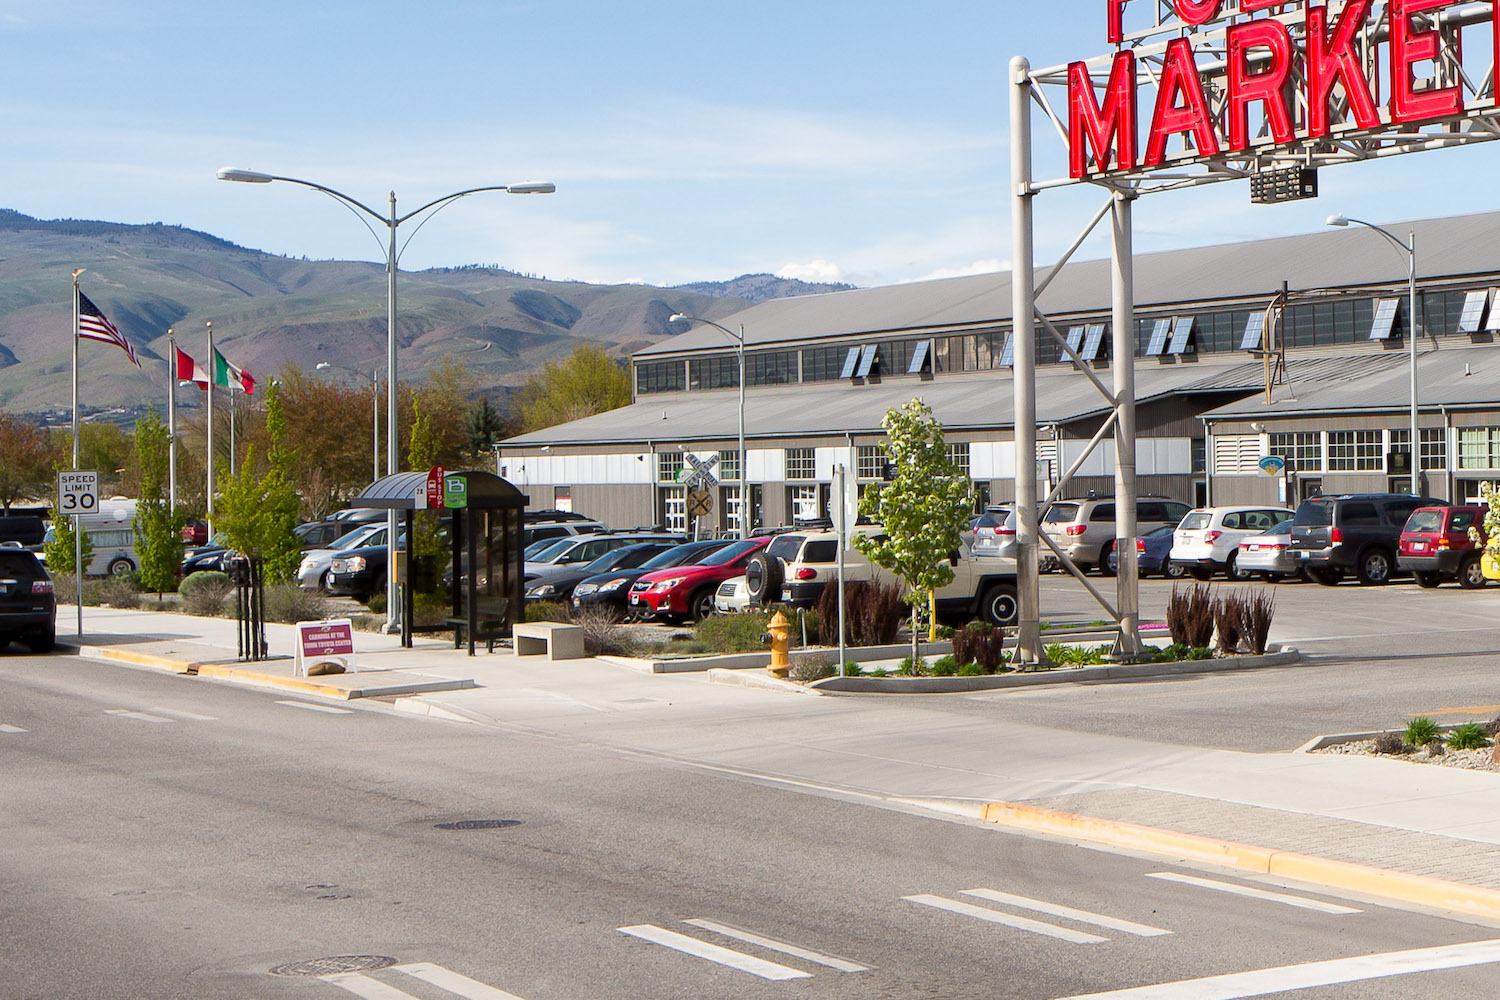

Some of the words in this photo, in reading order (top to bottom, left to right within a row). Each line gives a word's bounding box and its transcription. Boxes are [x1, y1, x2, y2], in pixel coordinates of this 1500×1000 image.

[1251, 167, 1300, 202] OPEN
[61, 475, 96, 484] SPEED
[65, 484, 92, 492] LIMIT
[63, 493, 95, 510] 30
